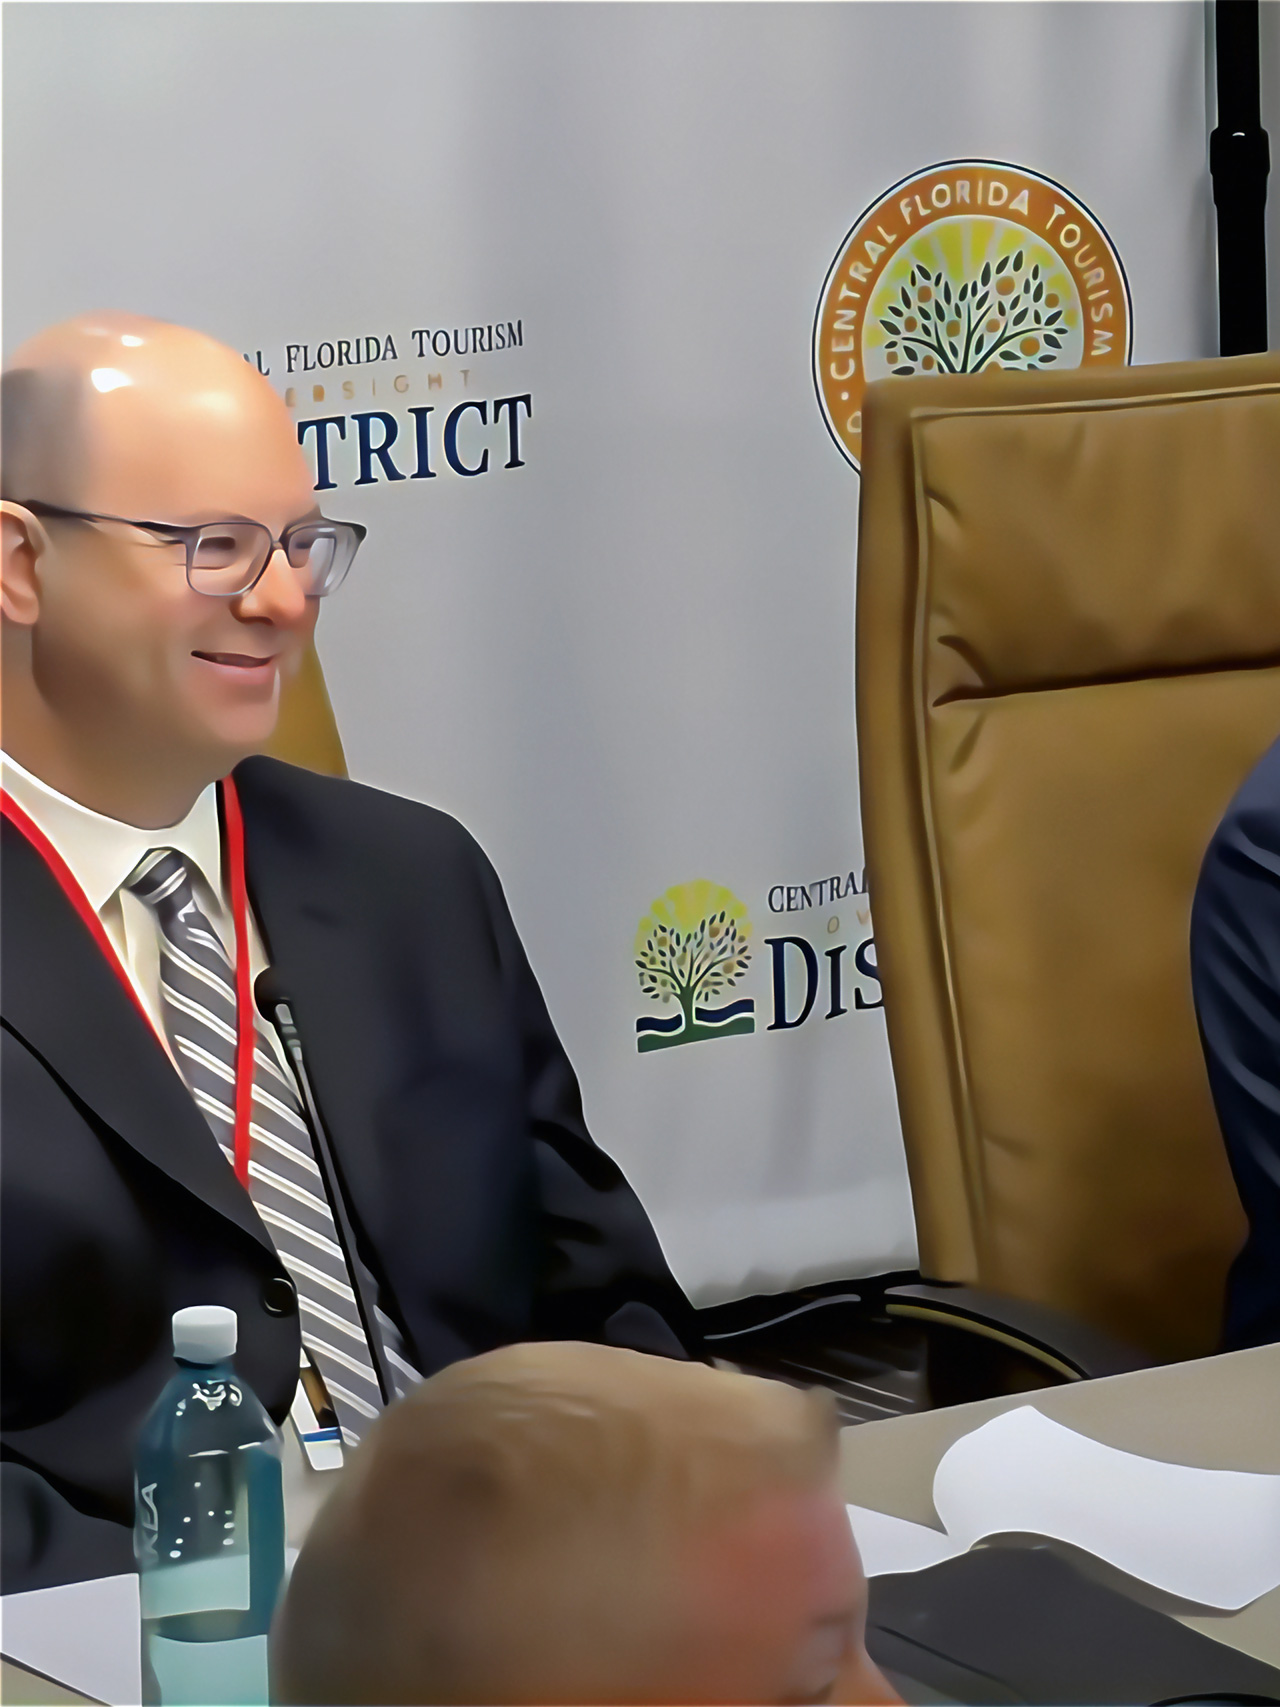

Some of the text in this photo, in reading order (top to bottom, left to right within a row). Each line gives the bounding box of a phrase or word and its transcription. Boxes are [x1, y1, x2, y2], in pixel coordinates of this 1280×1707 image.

[830, 180, 1114, 380] CENTRAL FLORIDA TOURISM
[286, 334, 398, 373] FLORIDA
[411, 319, 523, 357] TOURISM
[297, 394, 532, 491] TRICT
